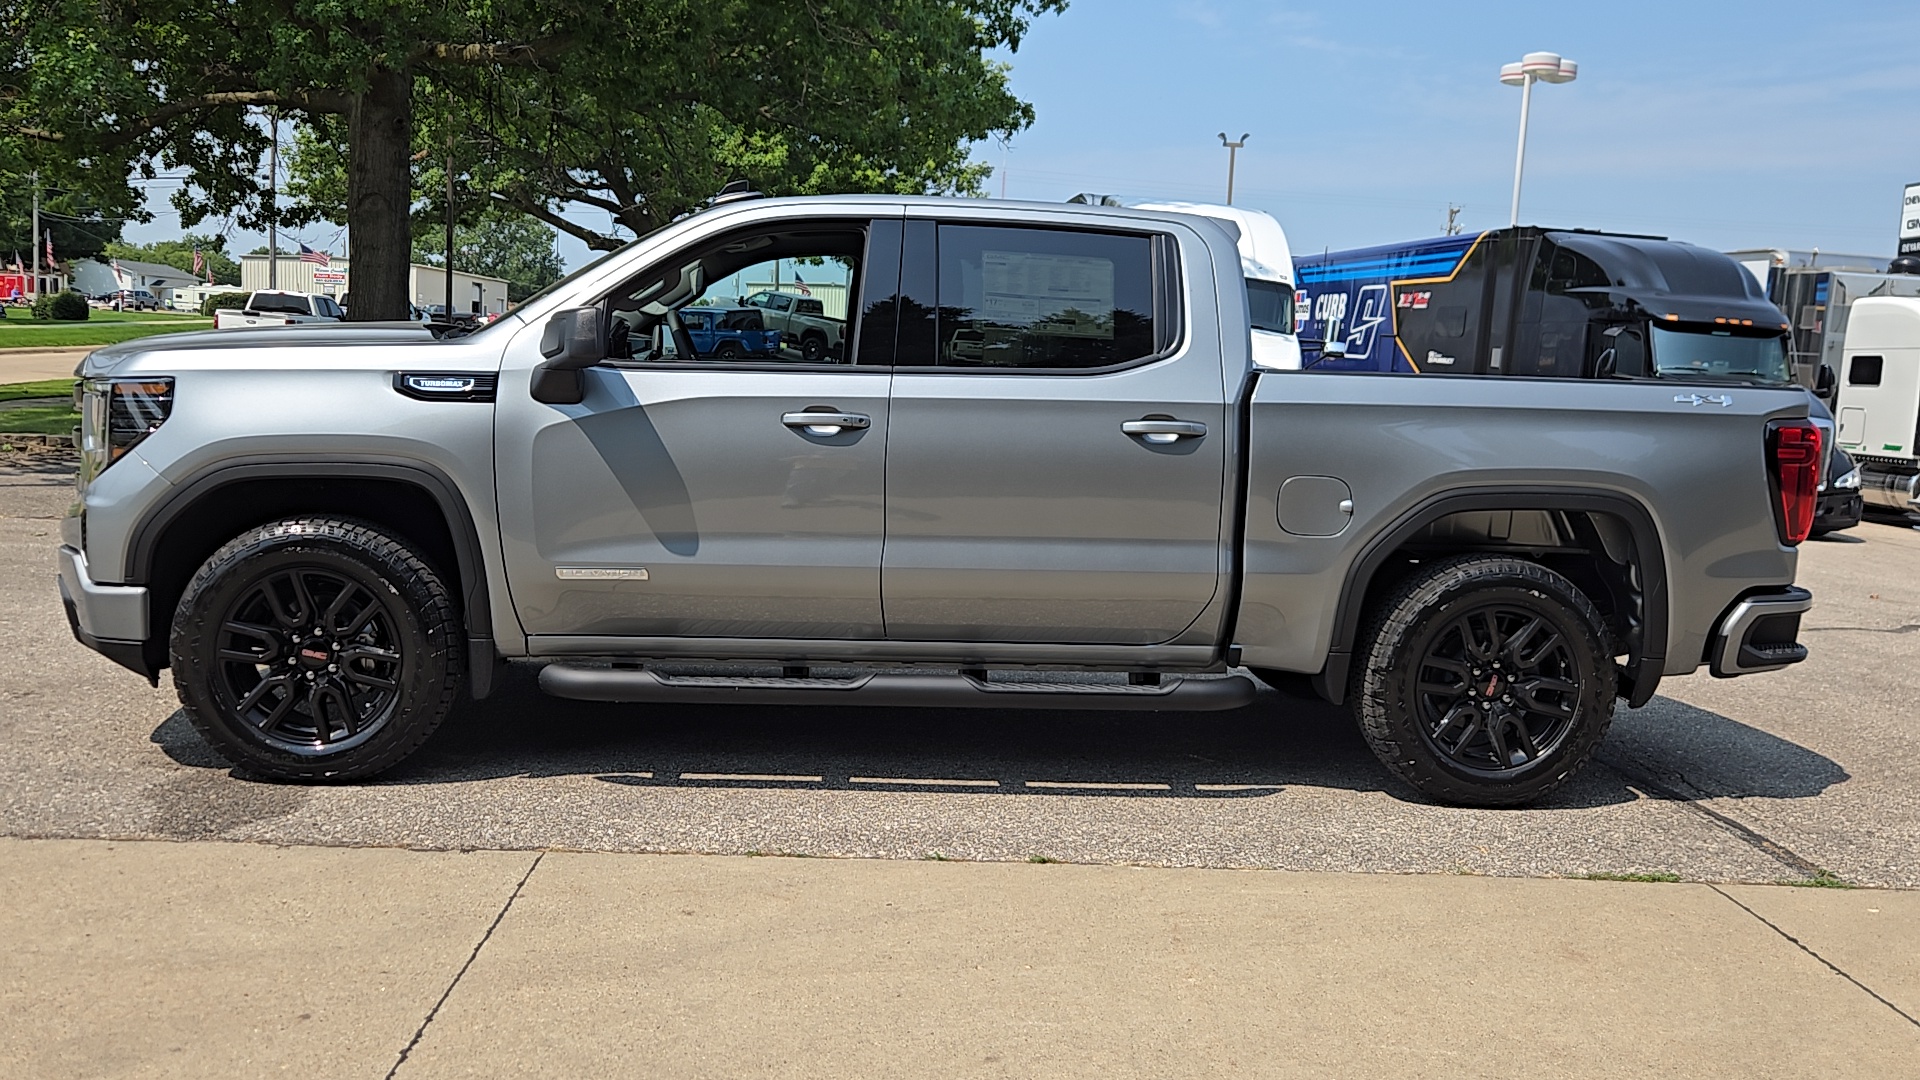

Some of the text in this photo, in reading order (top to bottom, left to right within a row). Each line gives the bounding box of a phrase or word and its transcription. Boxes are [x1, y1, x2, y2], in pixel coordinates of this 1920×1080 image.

[1315, 293, 1347, 320] CURB
[420, 380, 463, 388] TURBOMAX
[301, 648, 328, 660] GMC
[1485, 674, 1499, 697] GMC
